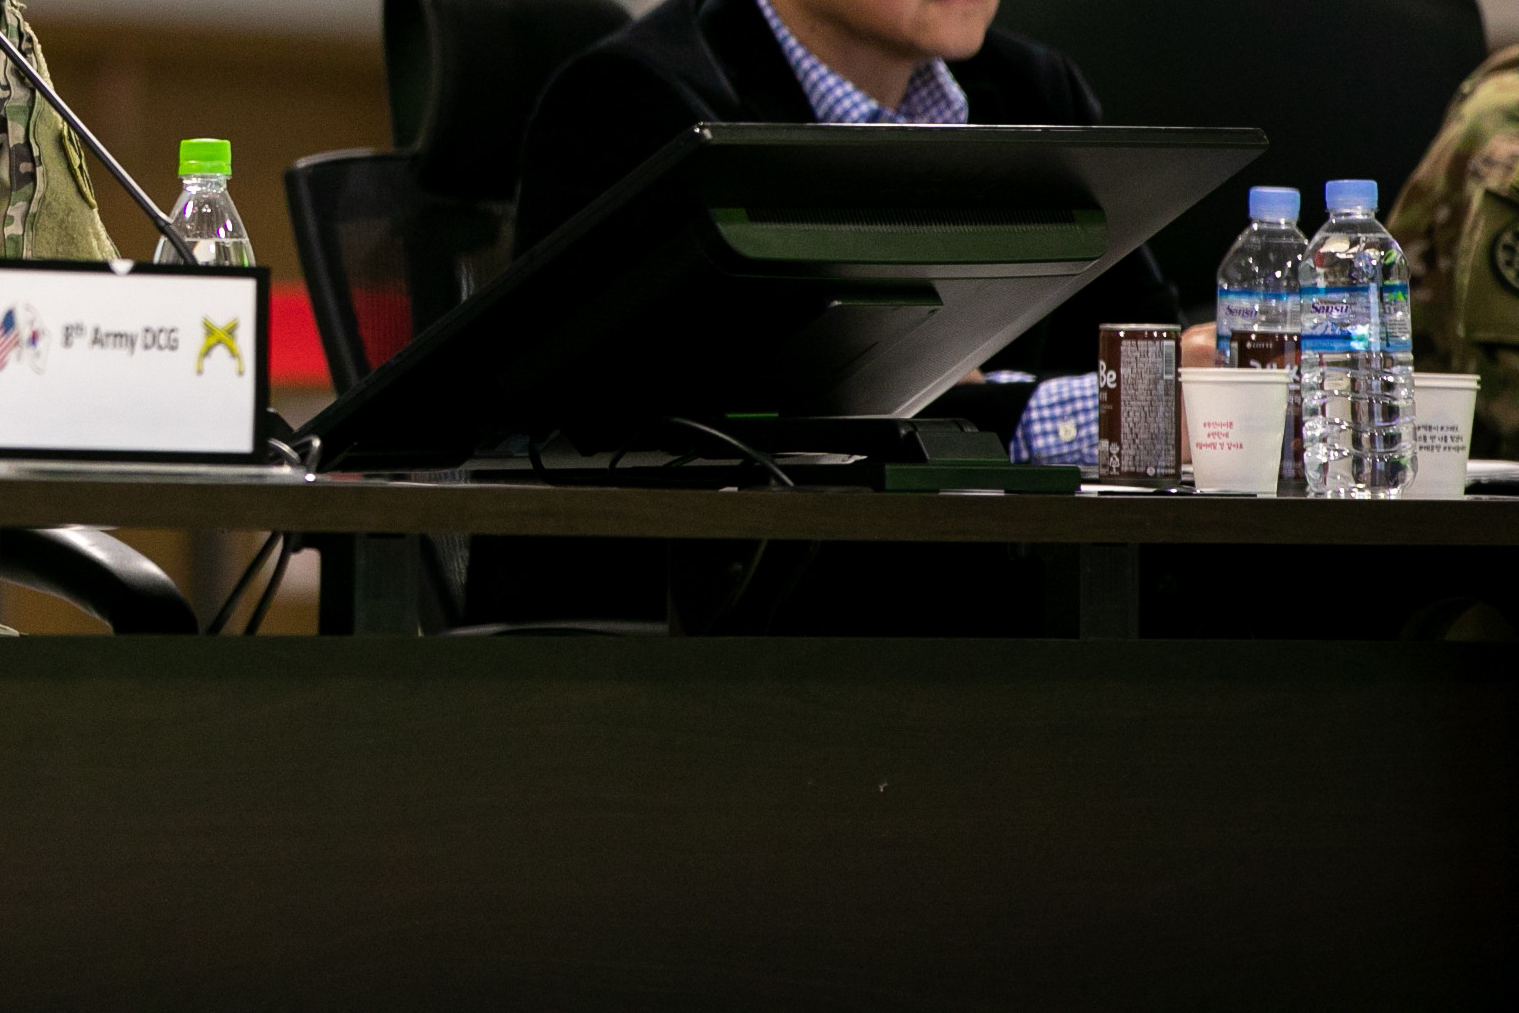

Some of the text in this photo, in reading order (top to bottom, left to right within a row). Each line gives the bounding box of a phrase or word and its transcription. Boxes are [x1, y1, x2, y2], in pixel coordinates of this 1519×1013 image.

[88, 325, 139, 356] Army
[141, 326, 180, 351] DCG
[1099, 360, 1117, 388] Be
